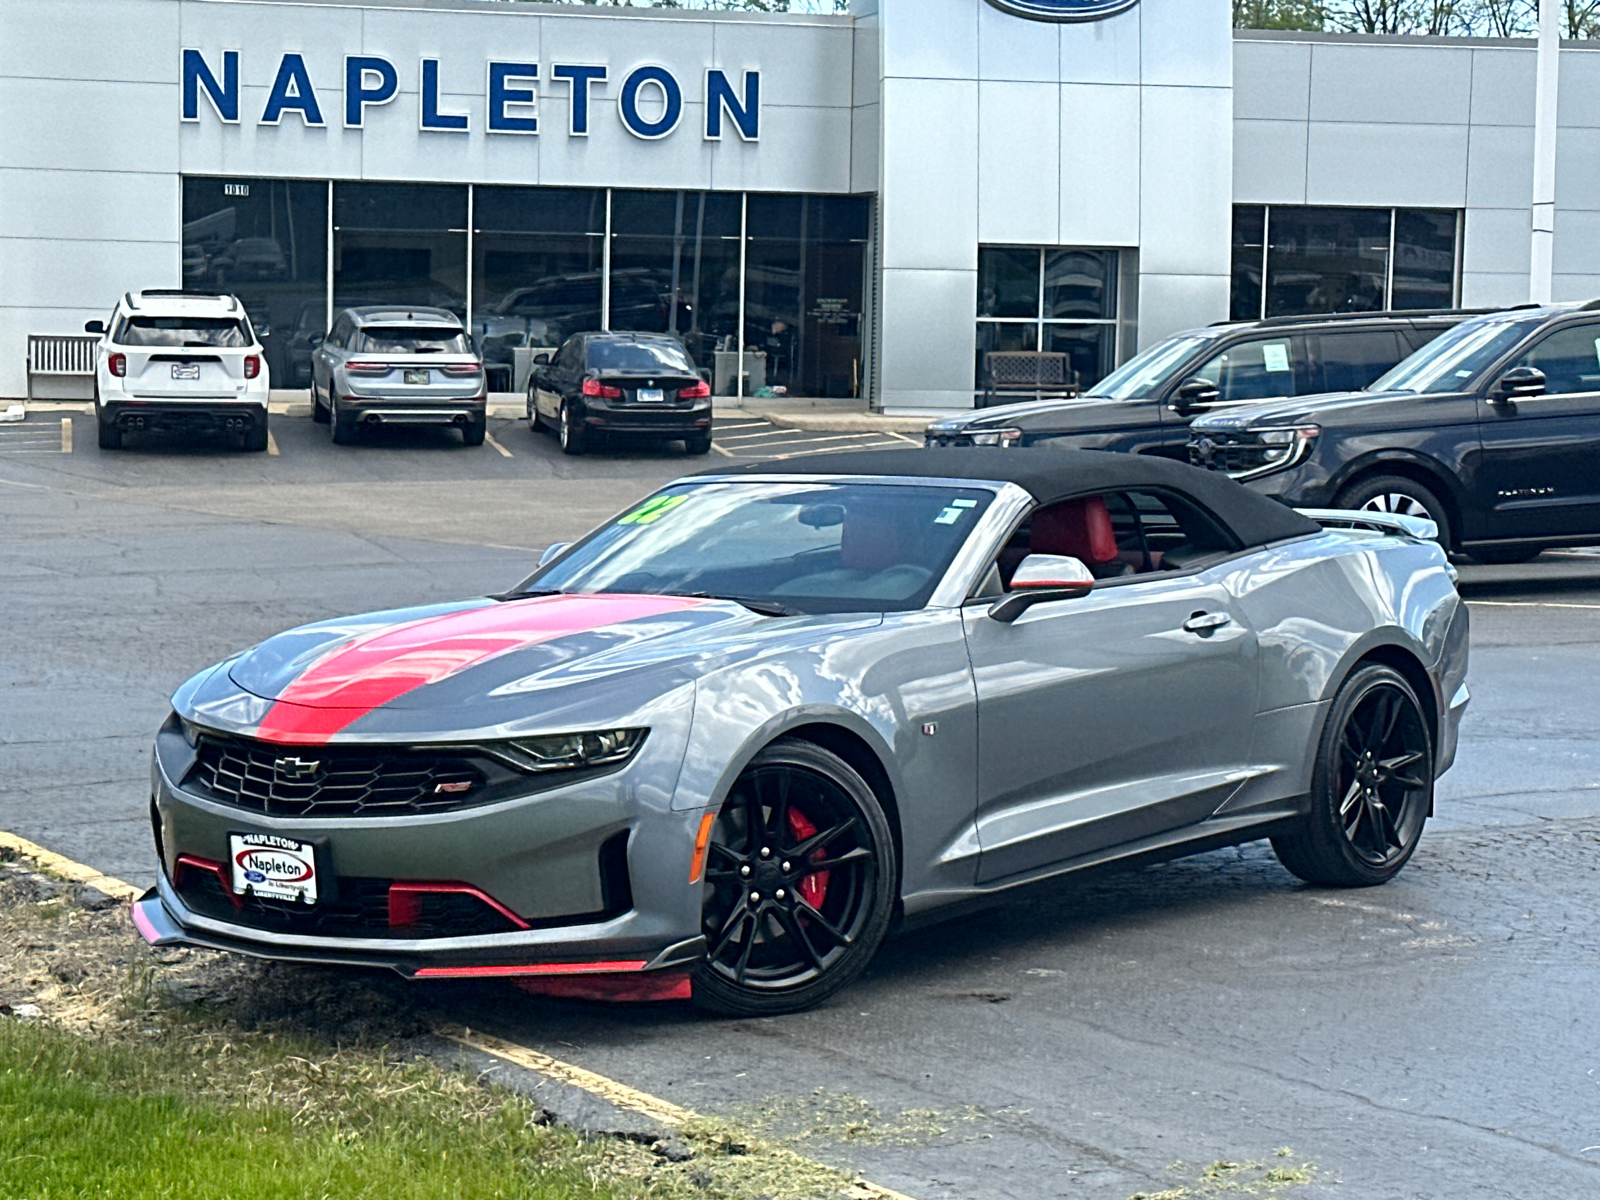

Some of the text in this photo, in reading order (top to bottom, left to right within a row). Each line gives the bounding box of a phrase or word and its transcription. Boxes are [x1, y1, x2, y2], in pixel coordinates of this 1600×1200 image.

[180, 47, 760, 142] NAPLETON
[225, 184, 249, 196] 1010
[246, 834, 294, 849] NAPLETON
[249, 854, 301, 875] Napleton
